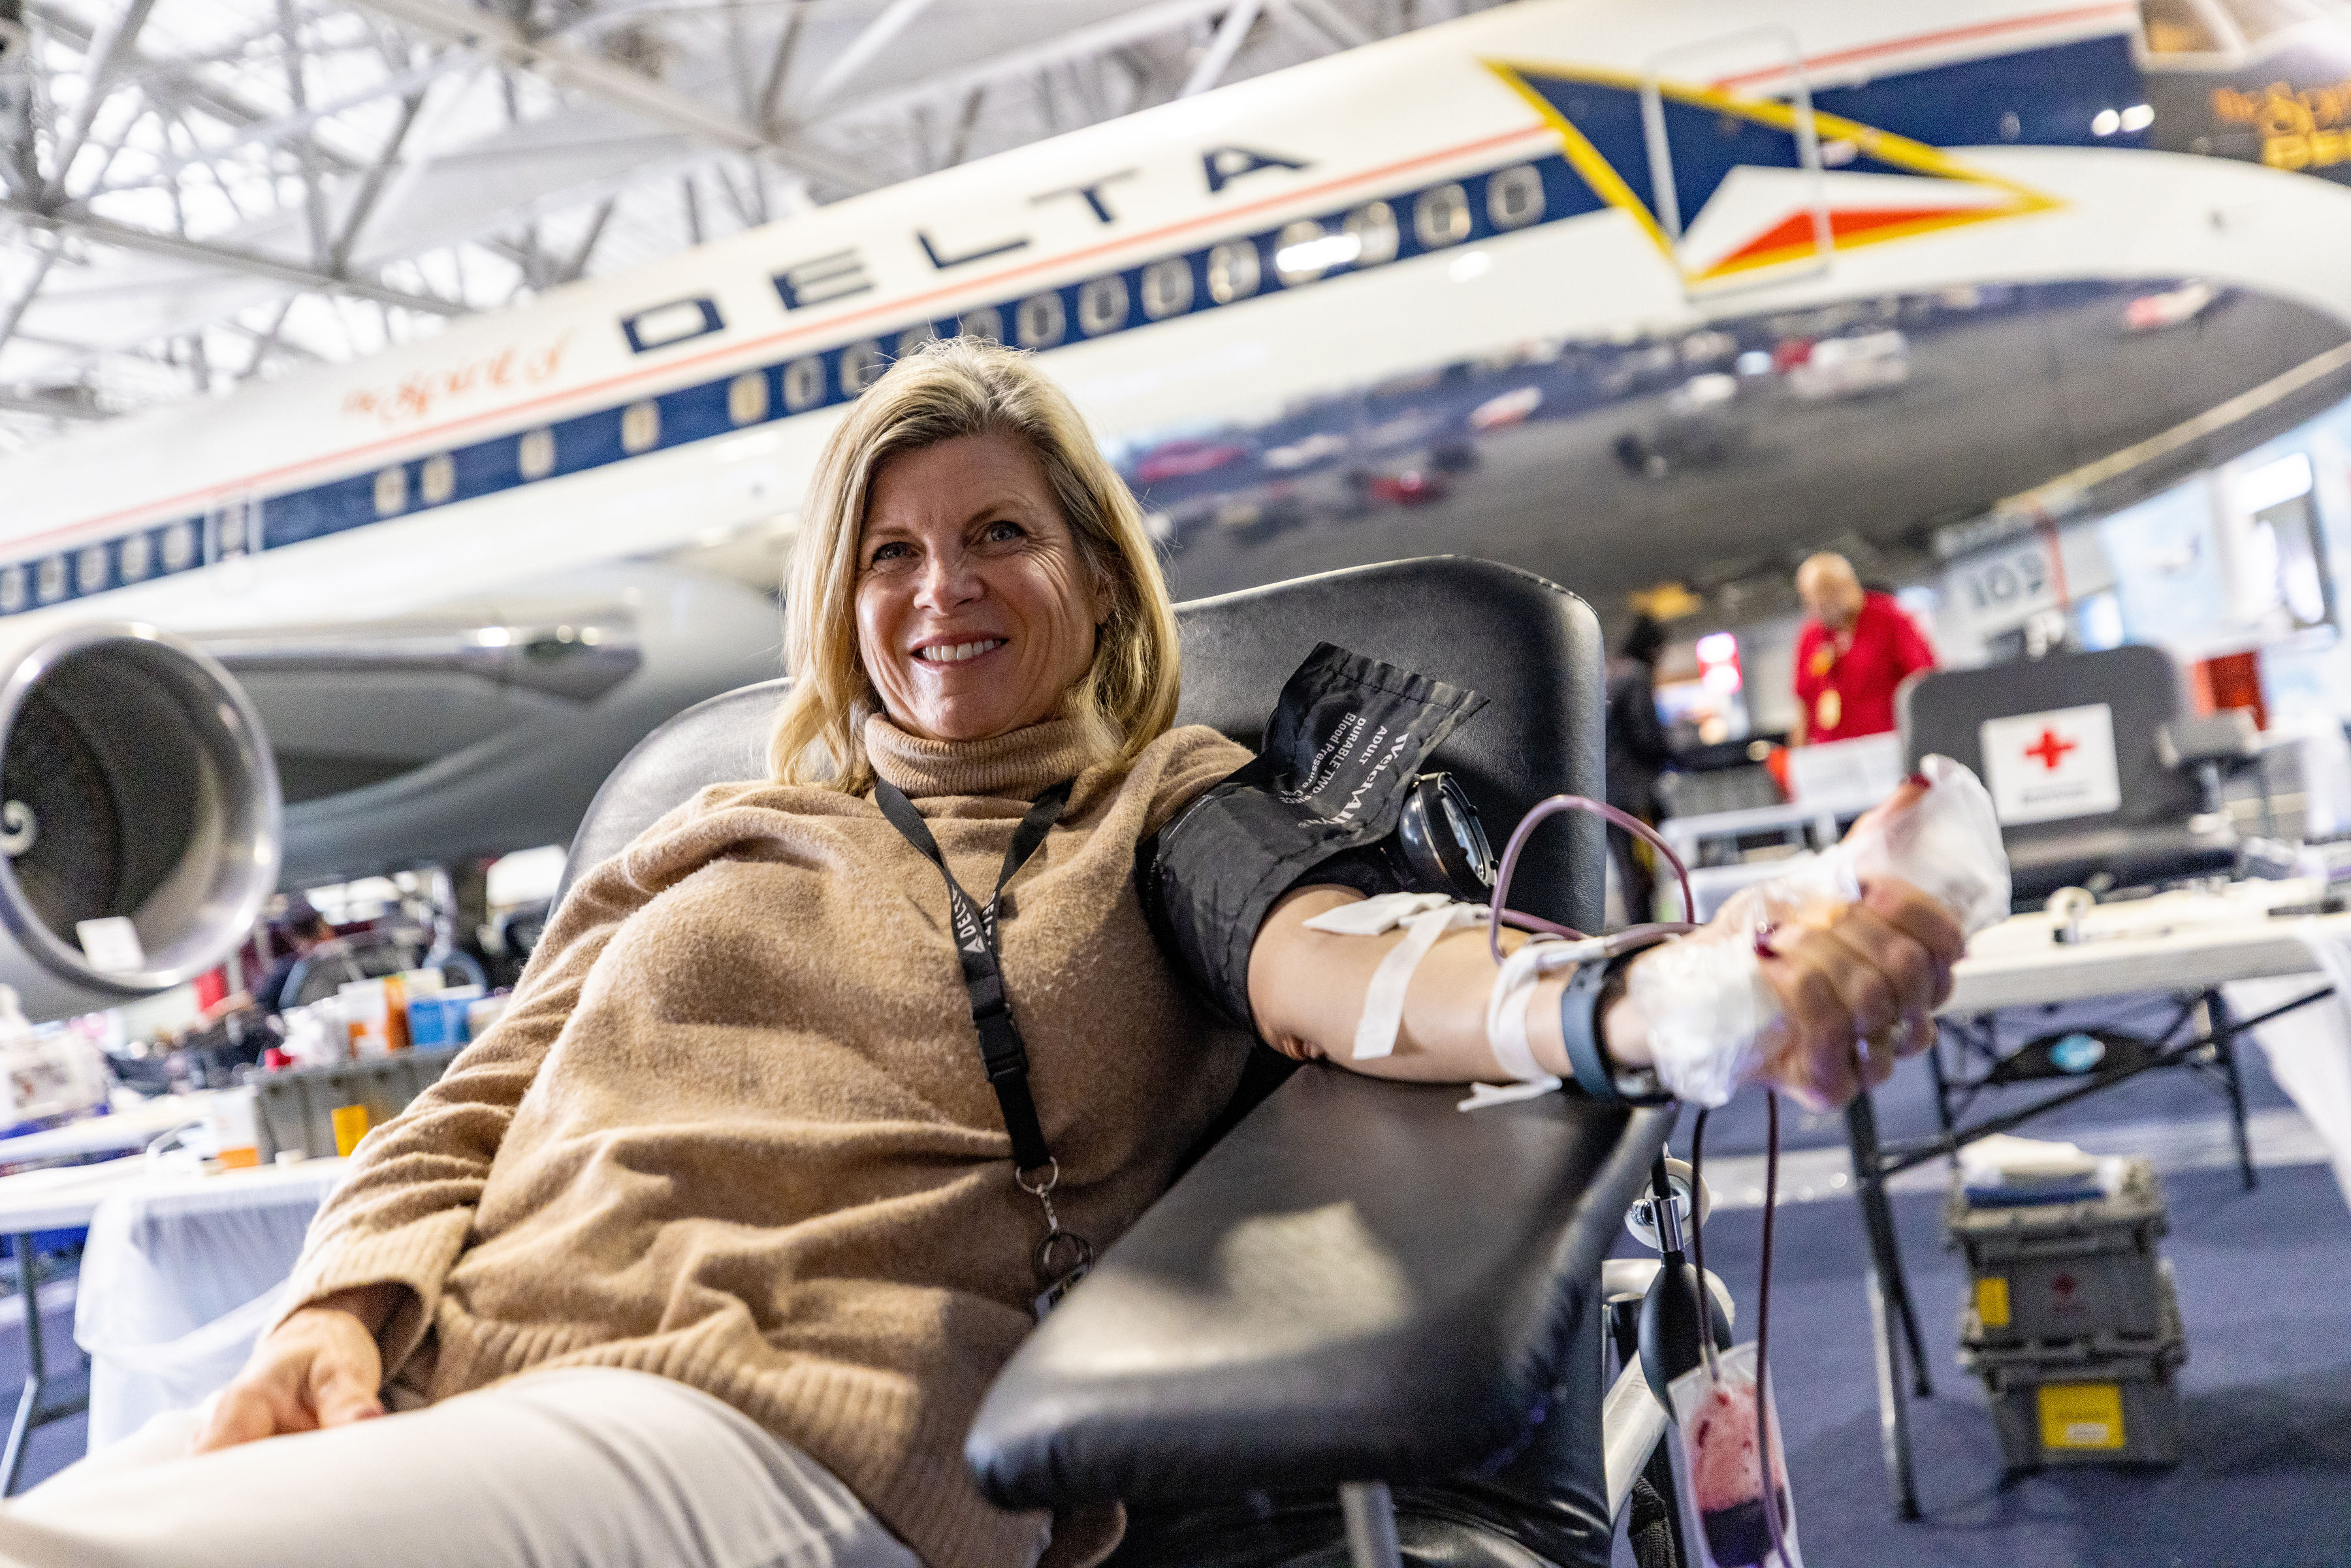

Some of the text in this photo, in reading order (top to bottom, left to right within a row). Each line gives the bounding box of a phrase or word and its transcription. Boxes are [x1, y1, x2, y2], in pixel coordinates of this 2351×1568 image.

[619, 144, 1317, 354] DELTA
[1328, 717, 1367, 769] DURABLE
[1329, 711, 1357, 744] Blood
[1358, 725, 1388, 765] ADULT
[1302, 743, 1335, 788] Pressure
